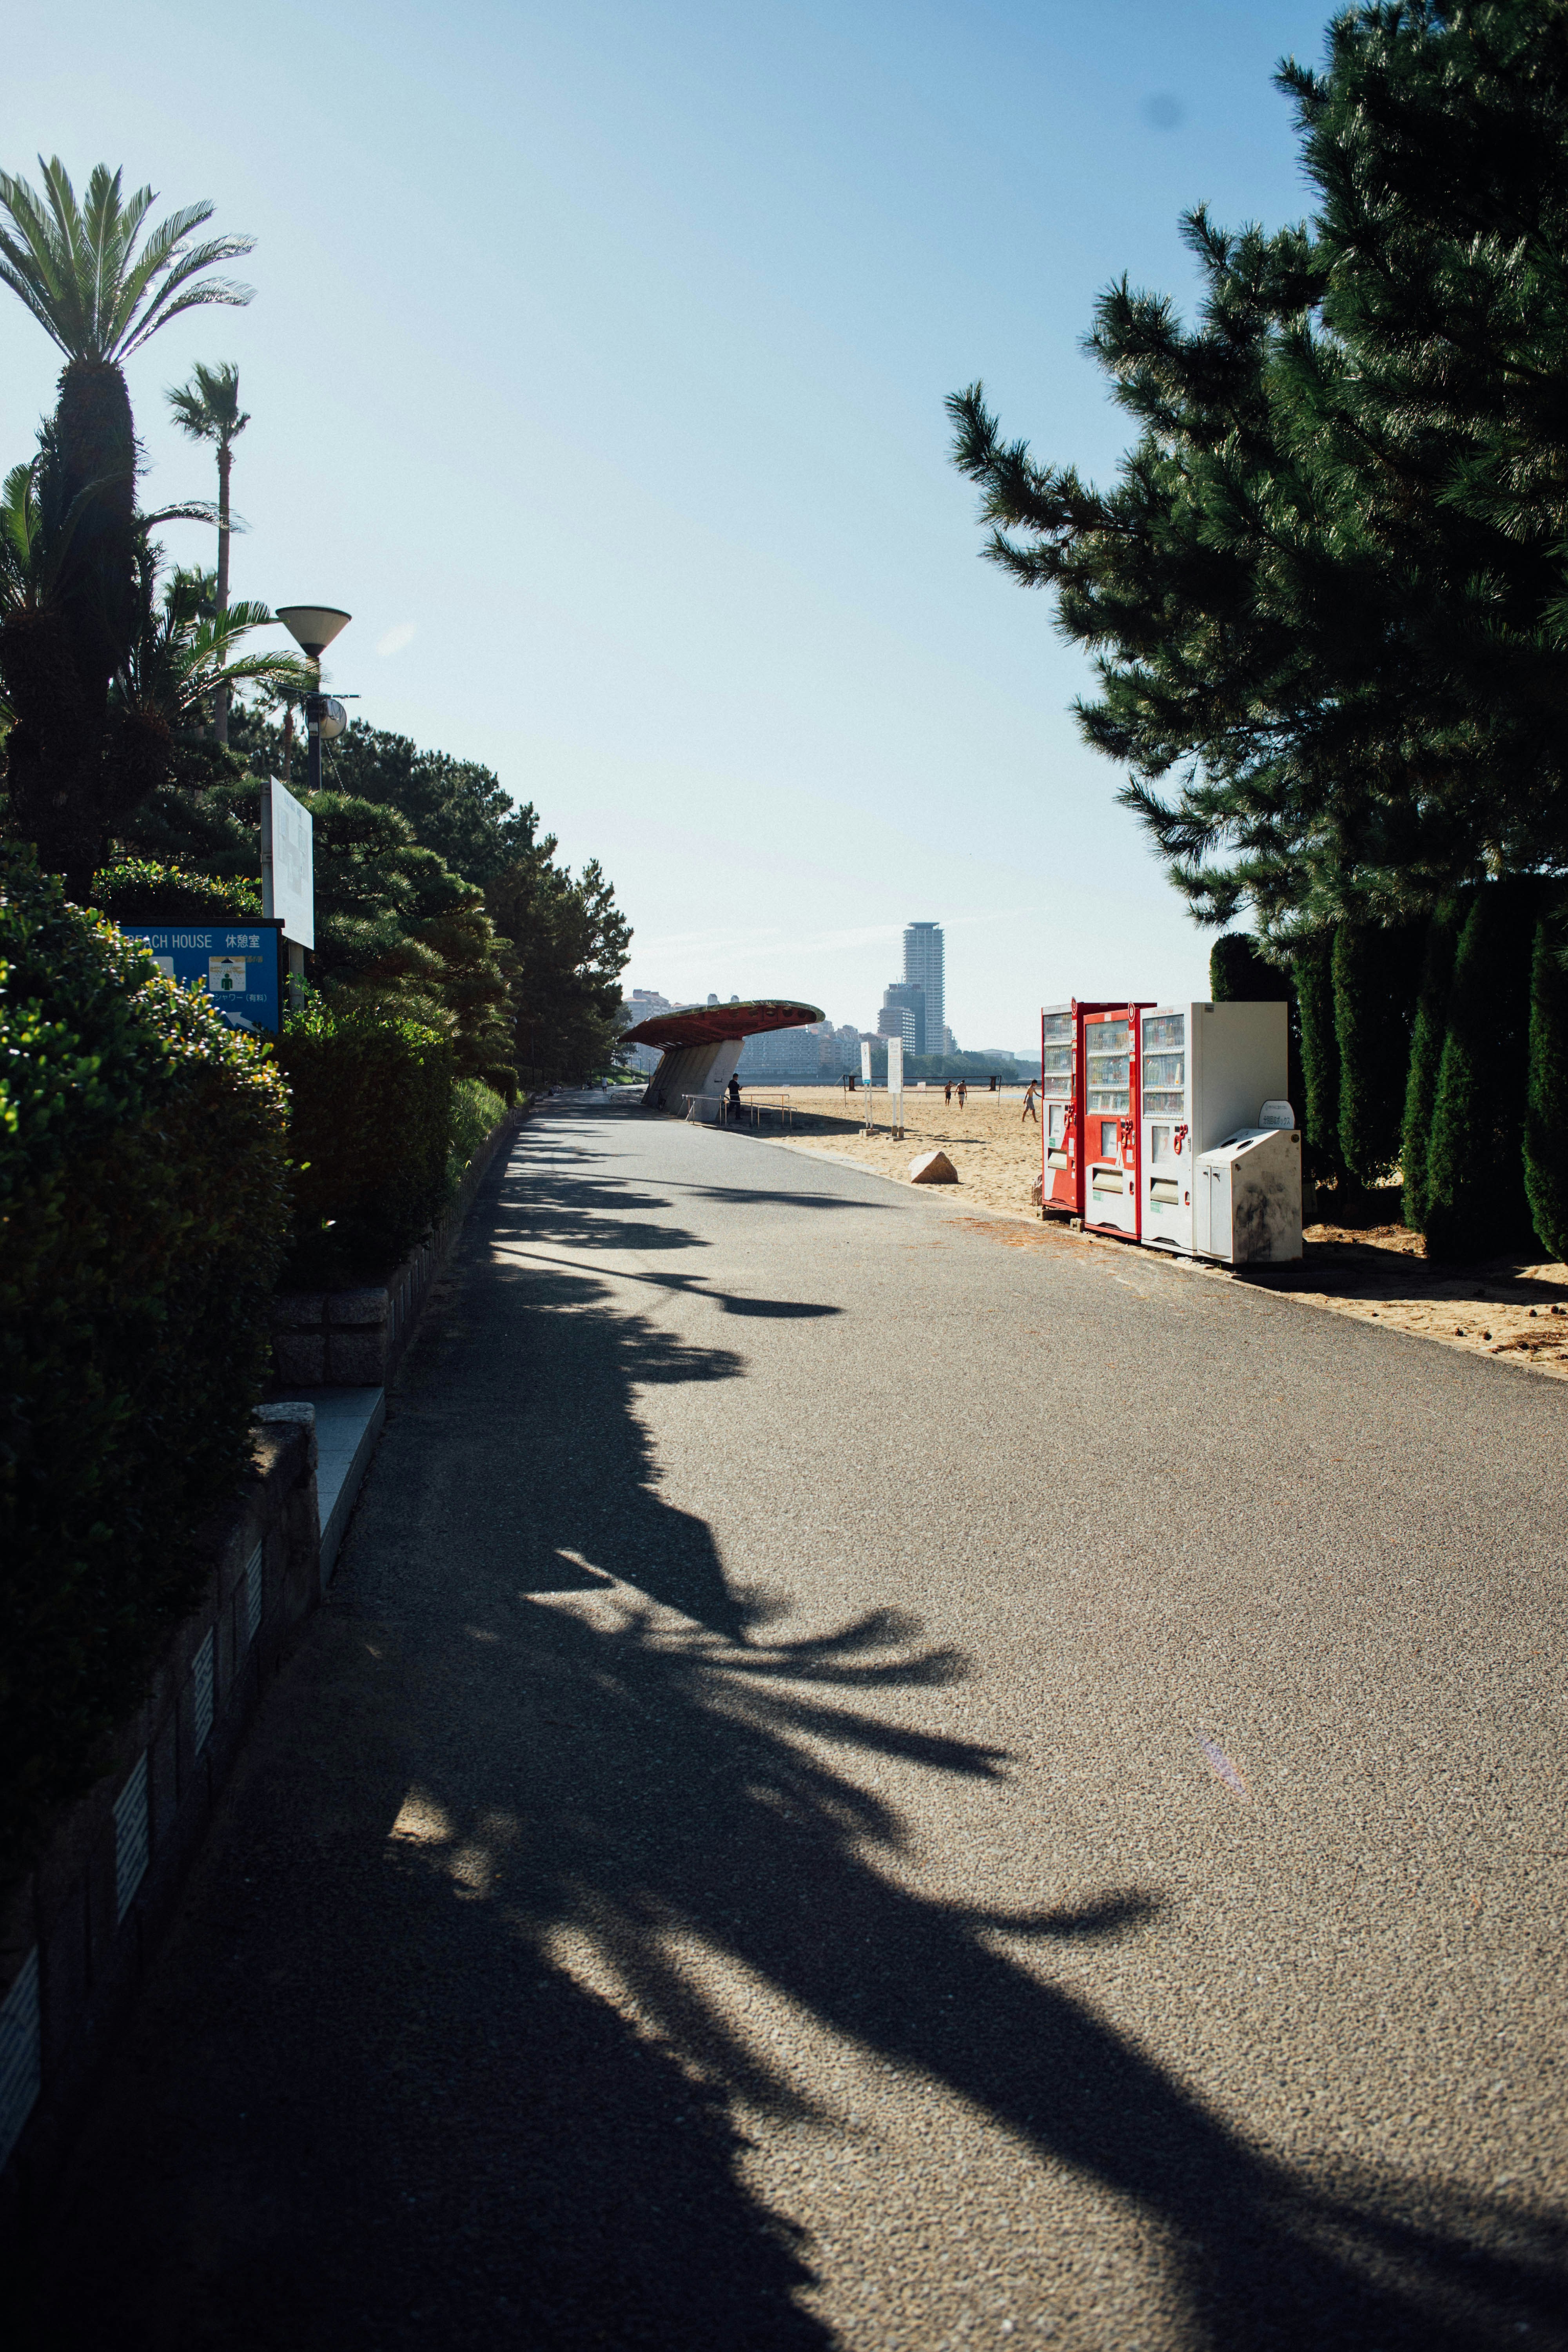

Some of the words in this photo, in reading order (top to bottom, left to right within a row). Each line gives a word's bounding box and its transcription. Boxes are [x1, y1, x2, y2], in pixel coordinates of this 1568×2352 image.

[172, 935, 212, 948] HOUSE
[226, 935, 260, 947] 休憩室
